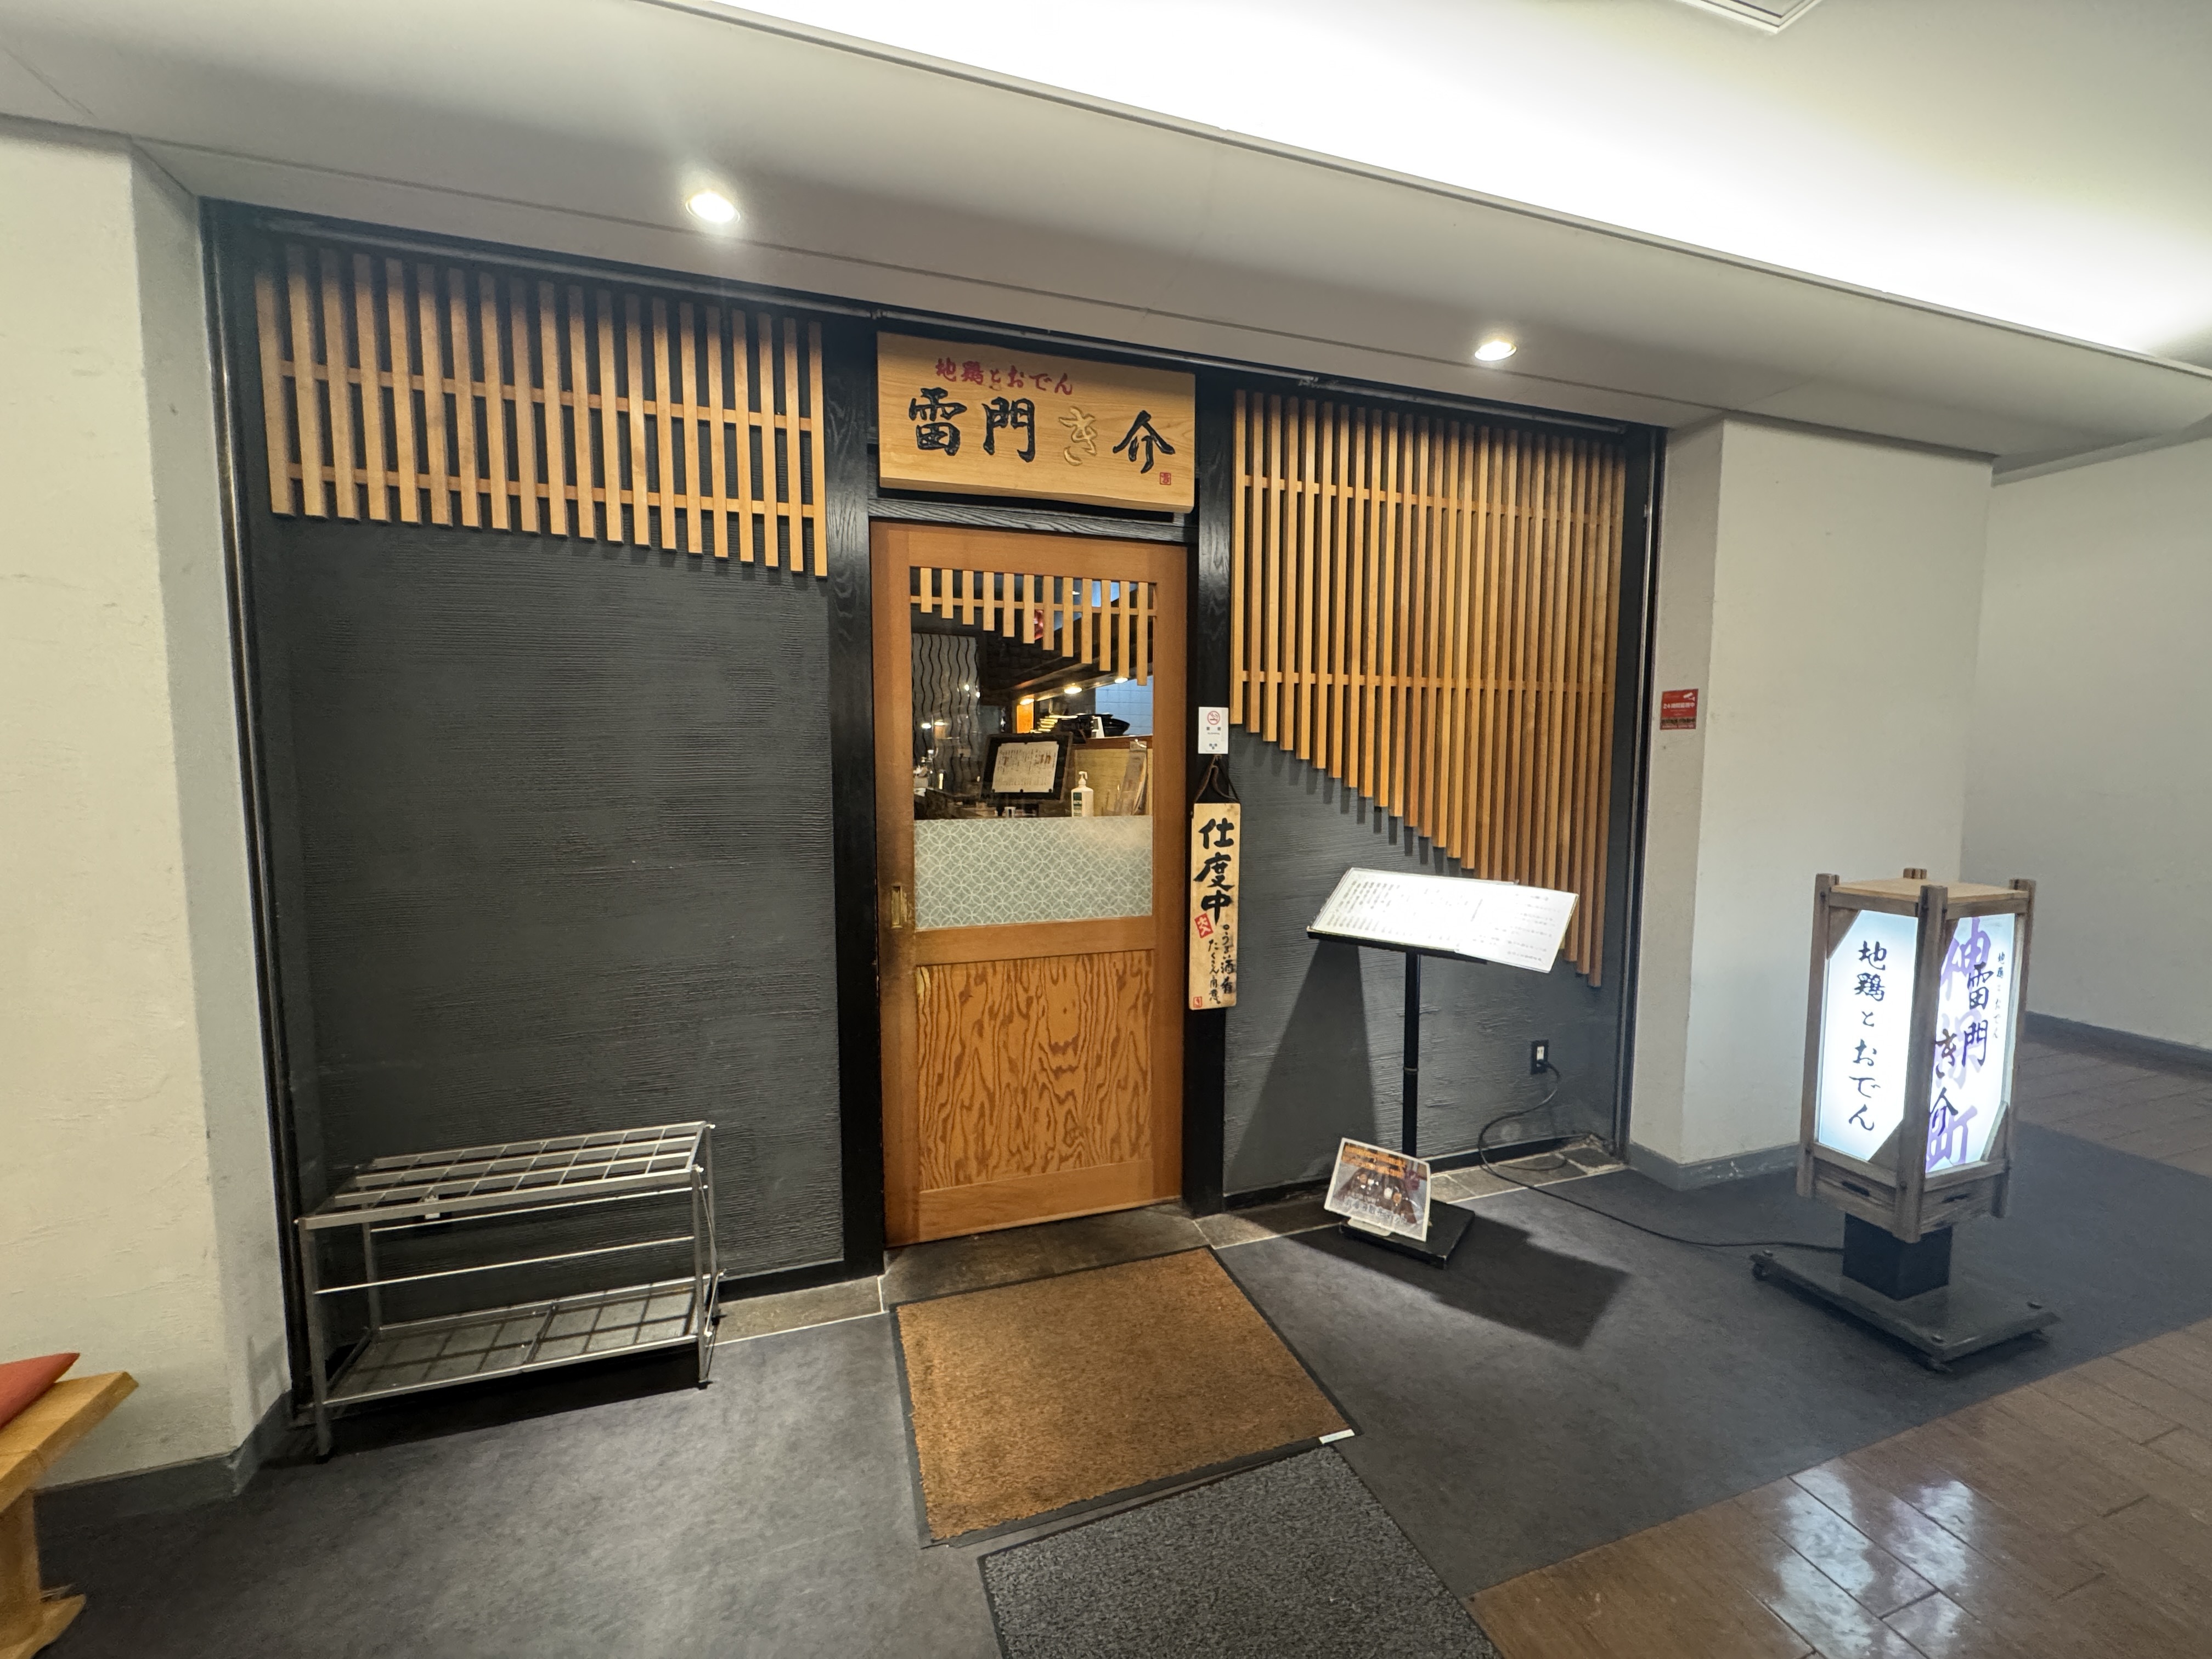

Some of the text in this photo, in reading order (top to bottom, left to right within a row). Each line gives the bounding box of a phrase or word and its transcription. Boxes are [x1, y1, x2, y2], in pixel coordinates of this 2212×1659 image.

[935, 357, 1073, 396] 地鶏とおでん
[1193, 817, 1235, 926] 仕度中
[1848, 940, 1888, 1132] 地鶏とおでん
